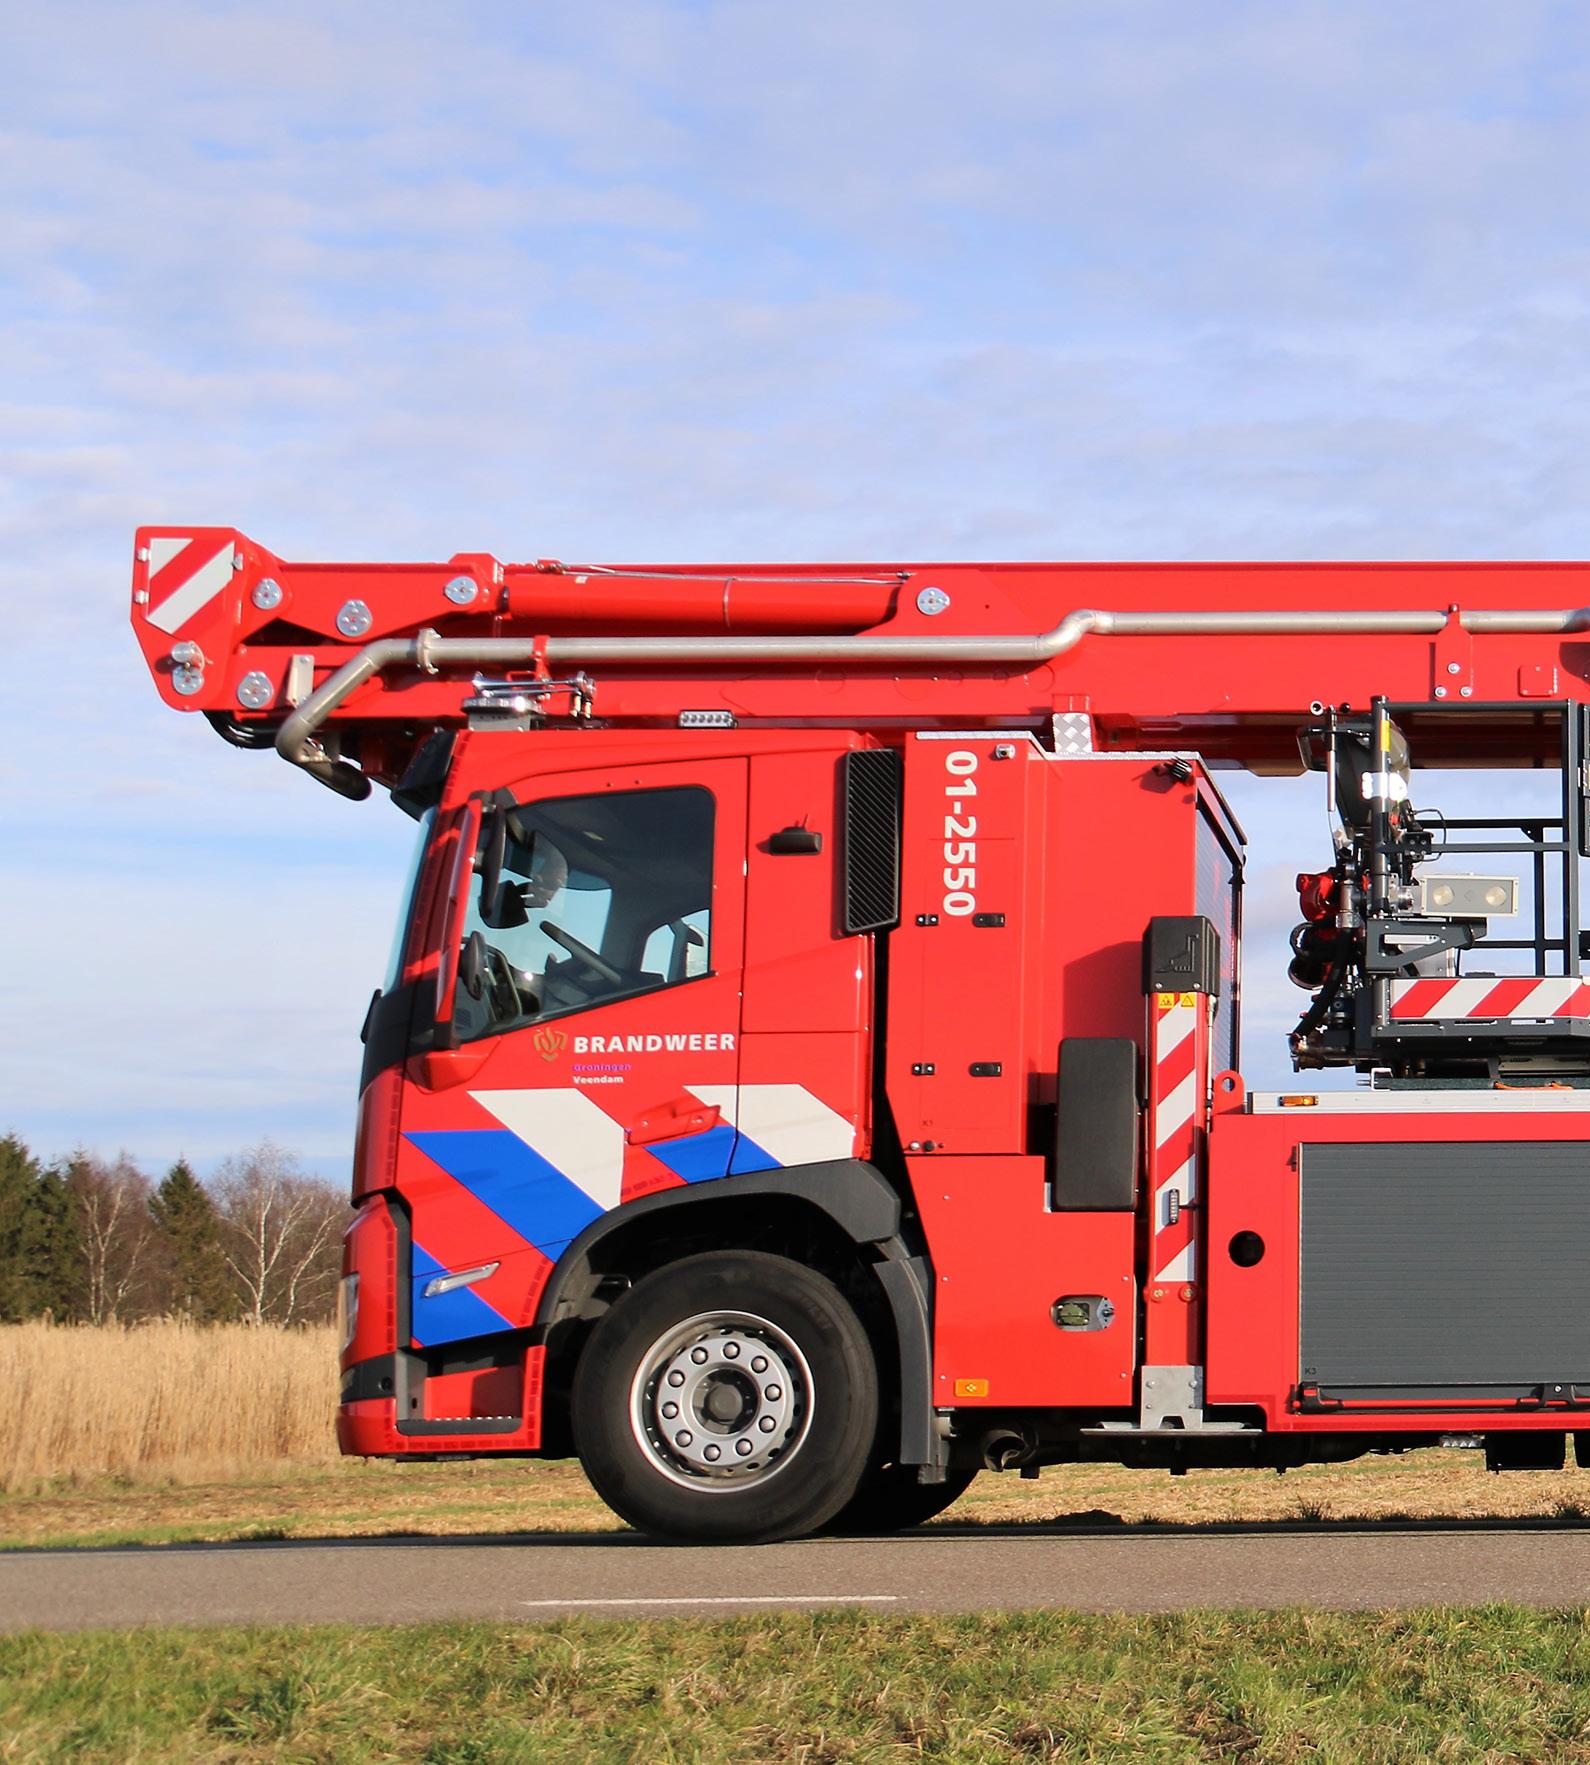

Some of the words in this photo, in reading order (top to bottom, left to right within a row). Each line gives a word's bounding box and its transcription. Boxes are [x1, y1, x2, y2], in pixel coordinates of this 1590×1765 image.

[943, 751, 978, 916] 01-2550
[574, 1033, 735, 1053] BRANDWEER
[573, 1075, 624, 1084] Veendam
[1304, 1367, 1317, 1375] K3
